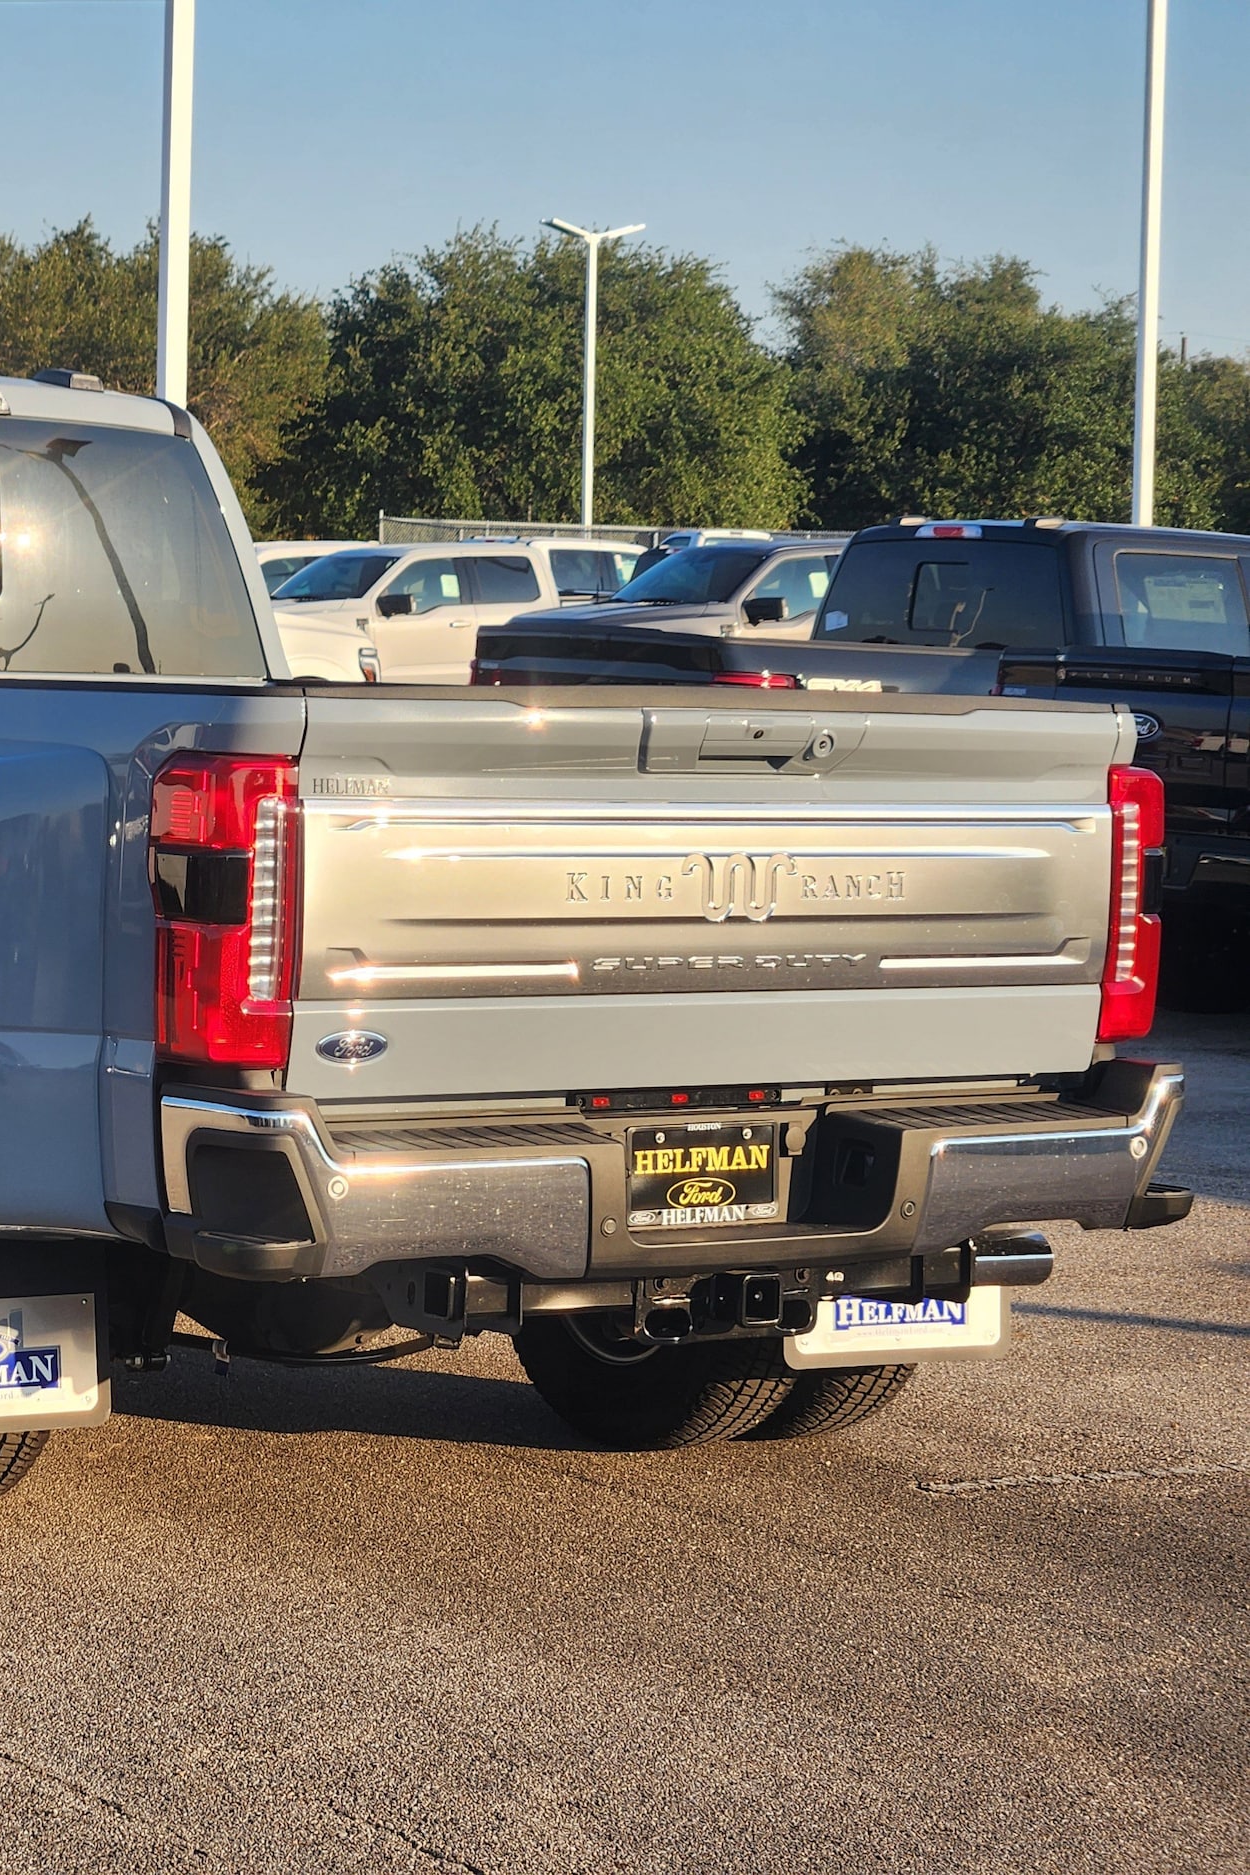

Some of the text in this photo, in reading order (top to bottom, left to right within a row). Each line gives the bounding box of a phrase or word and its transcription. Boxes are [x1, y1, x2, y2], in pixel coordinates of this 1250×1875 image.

[1070, 671, 1191, 684] PLATINUM
[312, 778, 389, 794] HELFMAN
[566, 871, 674, 902] KING
[801, 870, 905, 900] RANCH
[592, 953, 867, 972] SUPER DUTY
[687, 1122, 722, 1131] HOUSTON
[634, 1145, 770, 1175] HELFMAN
[679, 1181, 724, 1205] Ford
[661, 1204, 747, 1226] HELFMAN
[837, 1299, 963, 1326] HELFMAN
